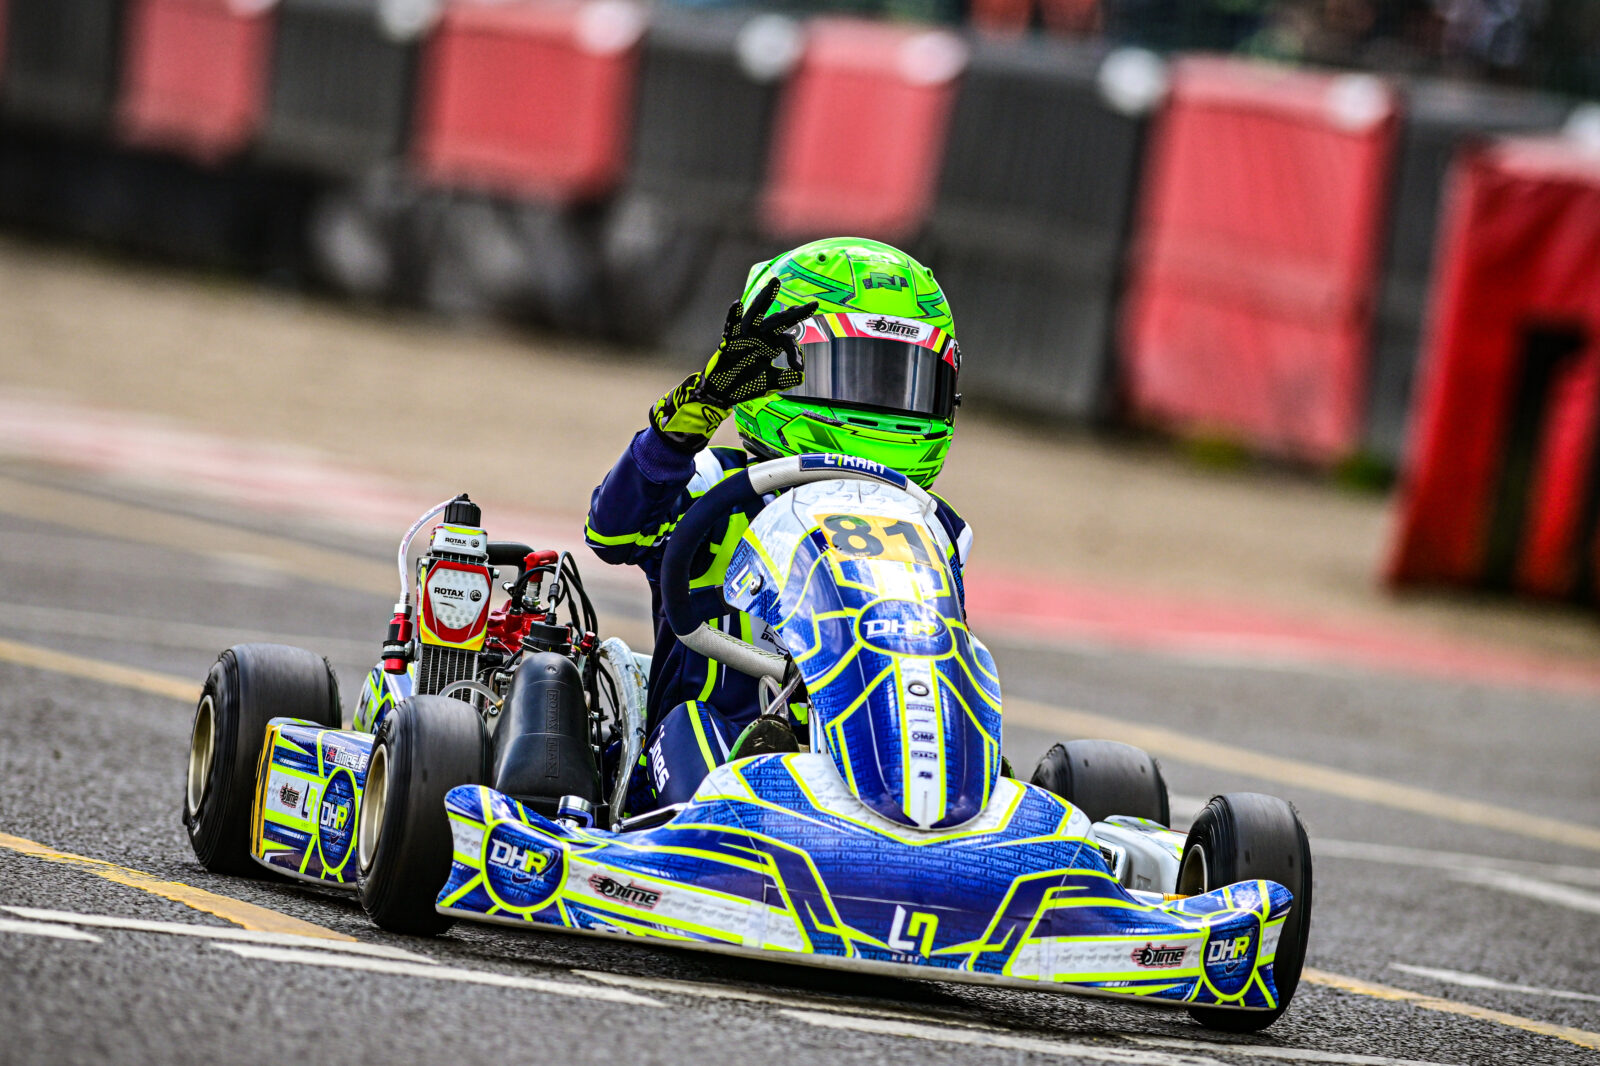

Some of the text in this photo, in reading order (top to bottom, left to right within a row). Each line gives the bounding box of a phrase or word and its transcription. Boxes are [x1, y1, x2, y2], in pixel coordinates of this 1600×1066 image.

[823, 514, 934, 568] 81
[434, 587, 464, 598] ROTAX
[912, 733, 934, 741] OMP
[321, 800, 348, 829] DHR
[490, 838, 548, 874] DHR
[891, 953, 920, 962] KART
[1208, 936, 1250, 962] DHR
